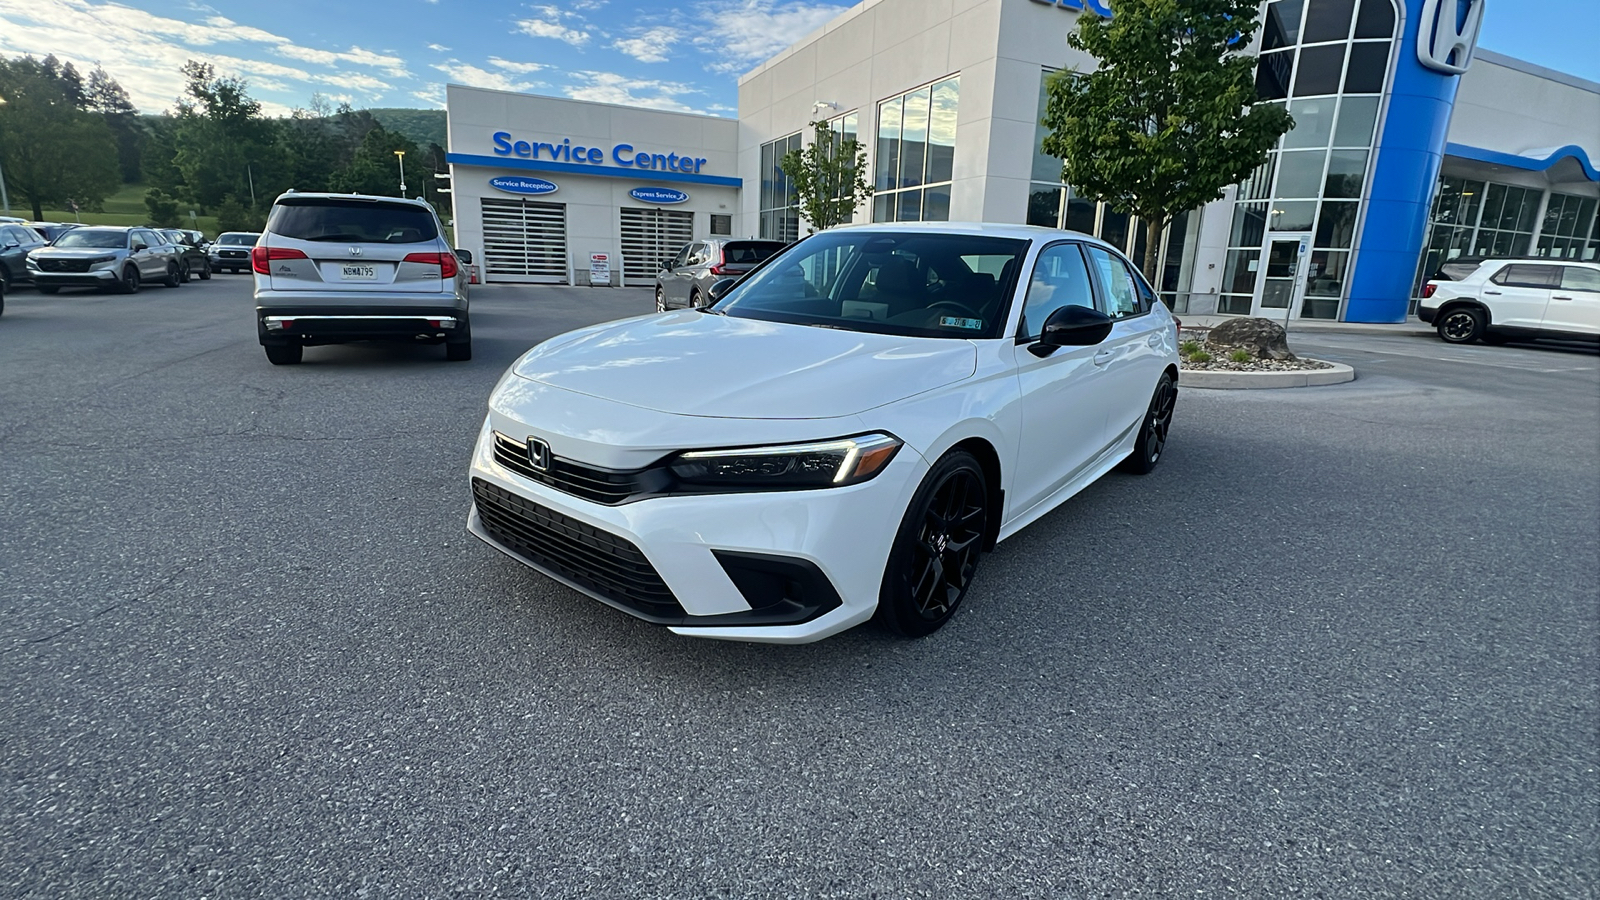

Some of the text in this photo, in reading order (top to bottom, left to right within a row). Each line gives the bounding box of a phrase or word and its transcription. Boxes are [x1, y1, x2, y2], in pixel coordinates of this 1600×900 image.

[493, 131, 707, 173] Service Center
[493, 179, 554, 190] Service Reception
[632, 190, 677, 199] Express Service
